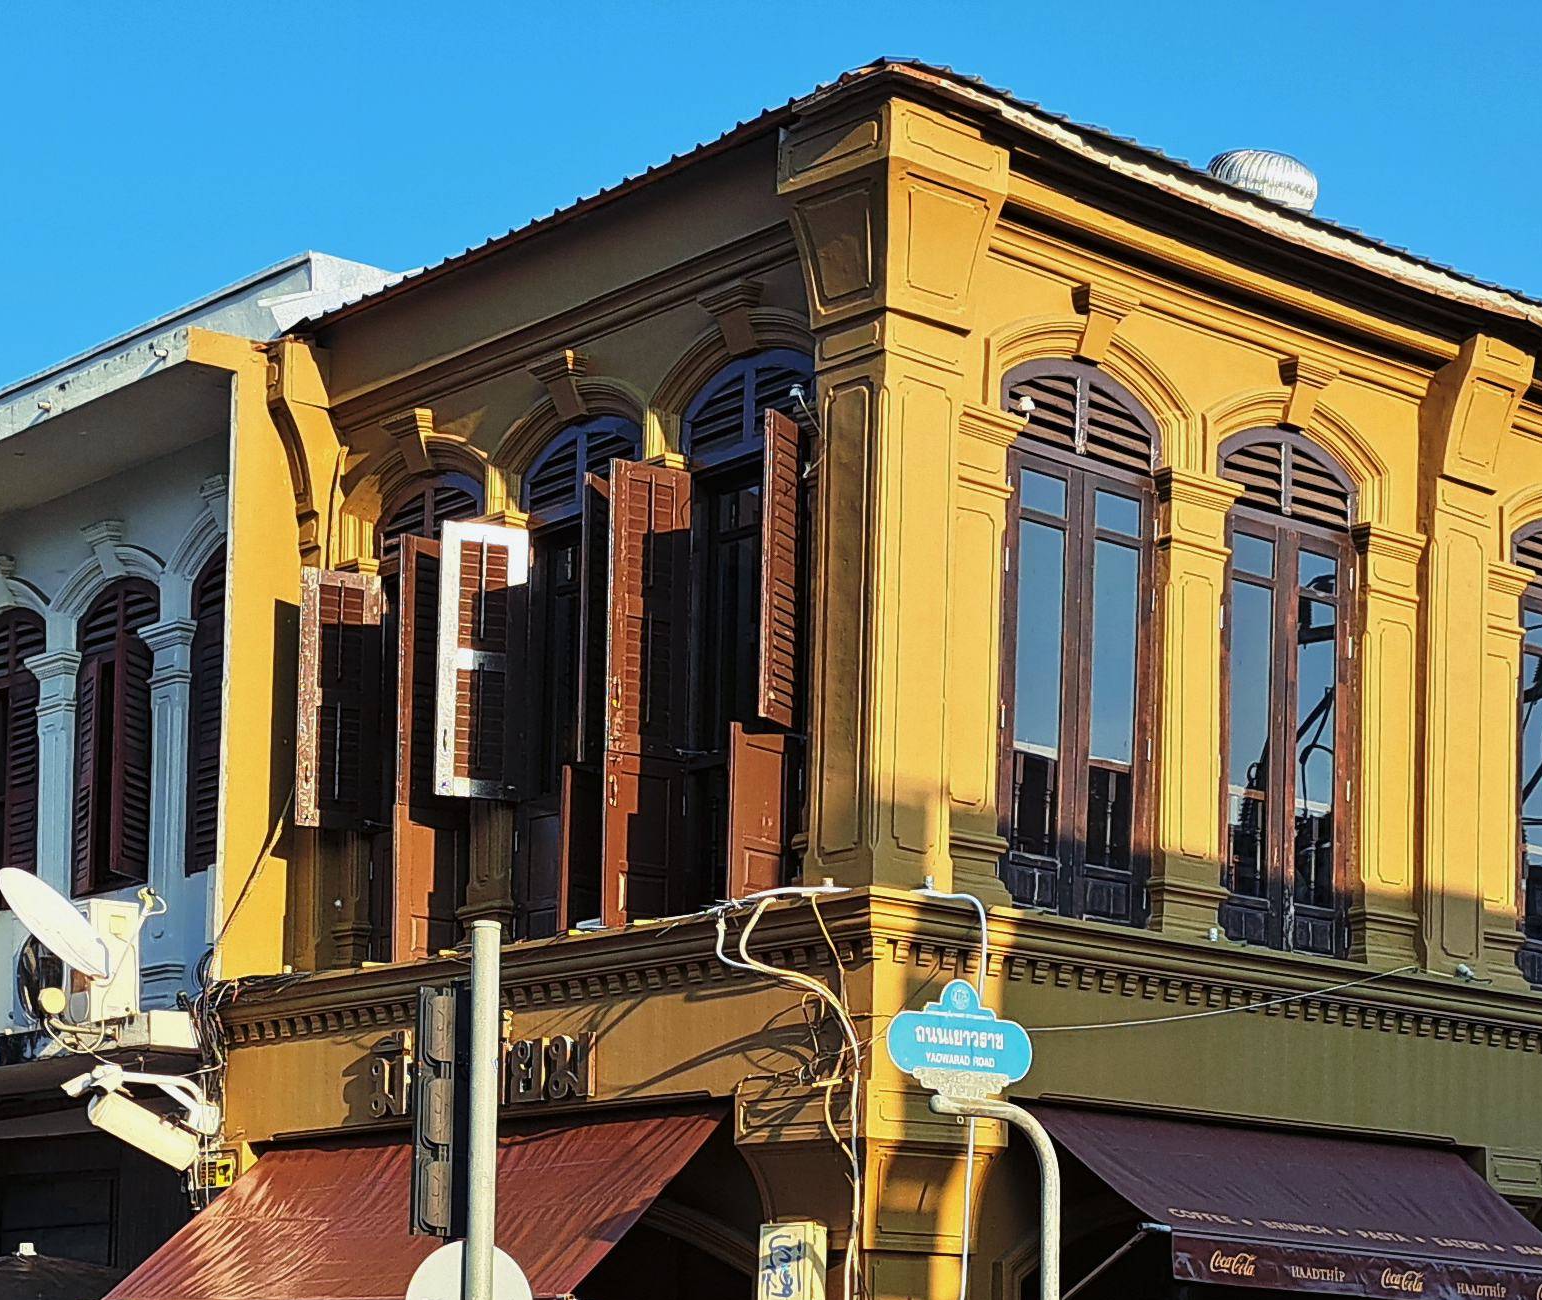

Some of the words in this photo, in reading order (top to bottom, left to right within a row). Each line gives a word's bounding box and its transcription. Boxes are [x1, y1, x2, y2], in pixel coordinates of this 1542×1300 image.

[972, 1056, 995, 1068] ROAD
[1168, 1208, 1236, 1225] COFFEE
[1260, 1220, 1333, 1236] BRUNCH
[1357, 1229, 1411, 1243] PASTA
[1432, 1237, 1493, 1252] EATERY
